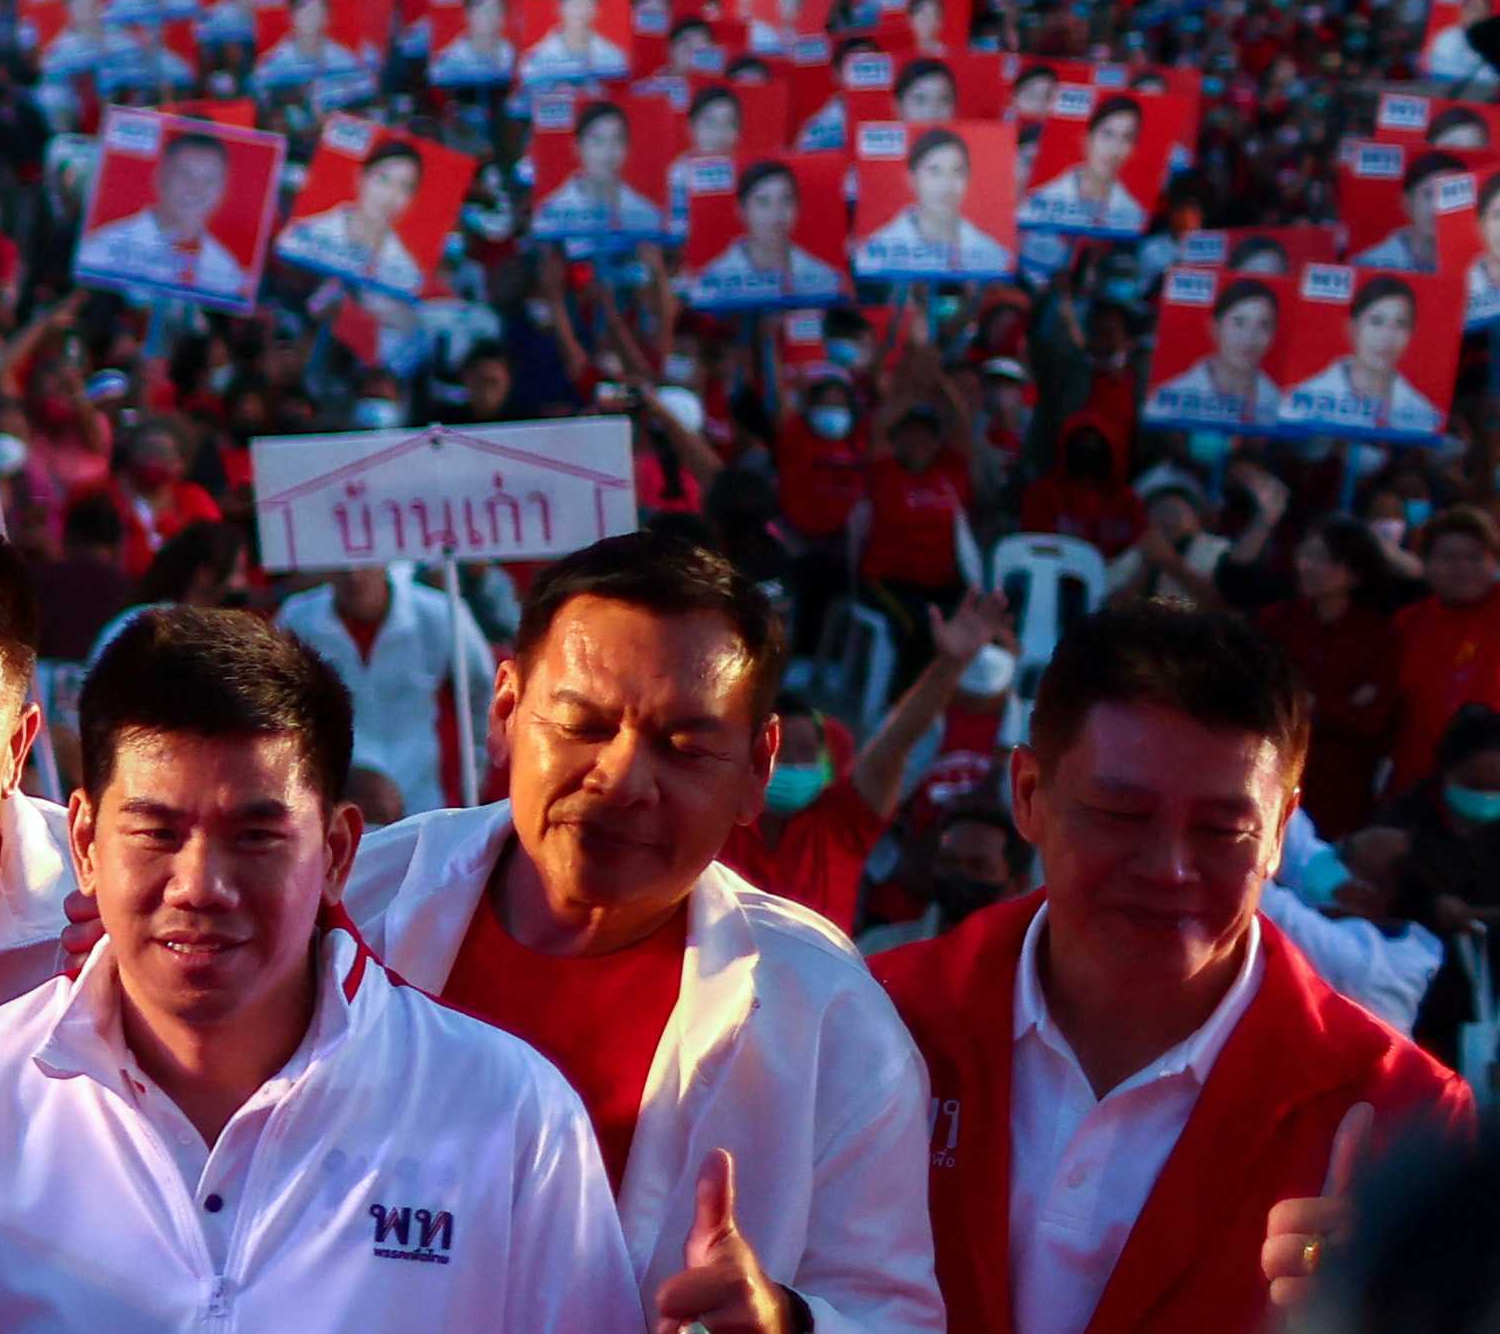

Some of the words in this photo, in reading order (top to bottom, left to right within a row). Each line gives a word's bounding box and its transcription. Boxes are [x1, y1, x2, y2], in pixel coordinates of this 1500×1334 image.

[332, 470, 554, 558] บ้านเก่า
[369, 1204, 454, 1250] พท
